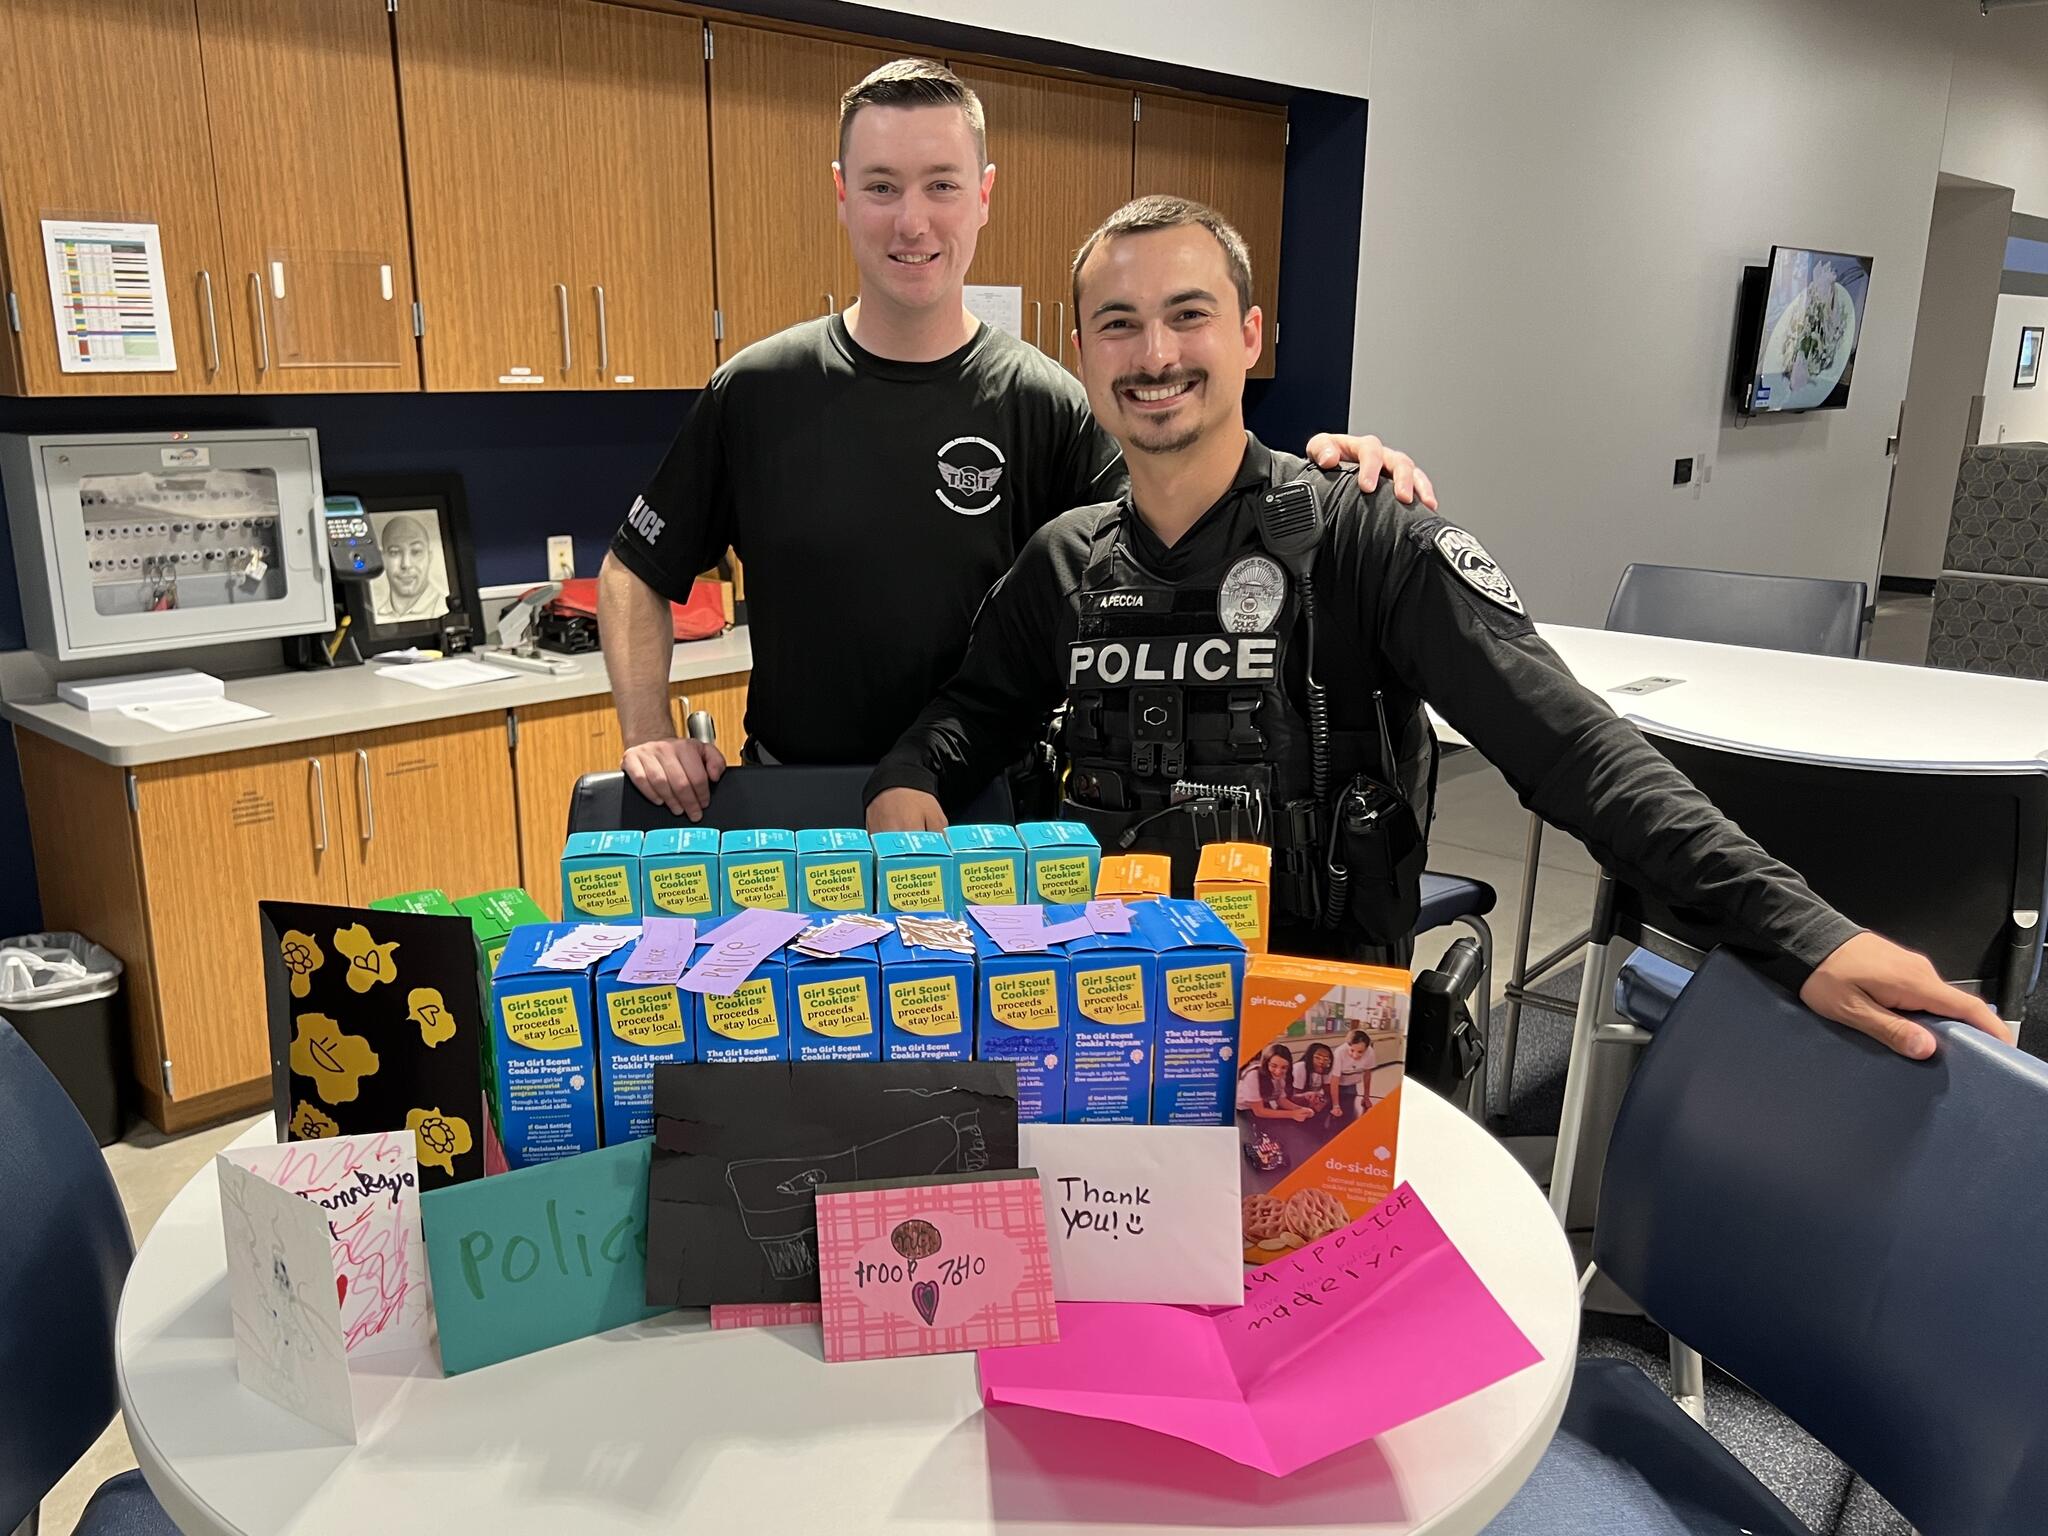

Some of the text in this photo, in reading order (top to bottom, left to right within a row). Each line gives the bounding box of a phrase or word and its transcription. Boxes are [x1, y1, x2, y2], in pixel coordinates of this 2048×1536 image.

[1232, 619, 1260, 629] POLICE
[1069, 638, 1277, 685] POLICE
[732, 866, 780, 879] Girl Scout
[810, 867, 856, 879] Girl Scout
[964, 864, 1010, 875] Girl Scout
[1040, 862, 1085, 873] Girl Scout
[573, 871, 622, 884] Girl Scout
[654, 870, 702, 882] Girl Scout
[738, 875, 776, 886] Cookies
[815, 875, 852, 886] Cookies
[890, 871, 937, 883] Girl Scout
[969, 872, 1006, 883] Cookies
[1045, 870, 1081, 880] Cookies
[580, 881, 618, 891] Cookies
[660, 879, 699, 889] Cookies
[736, 884, 774, 896] proceeds
[813, 884, 850, 896] proceeds
[896, 880, 933, 890] Cookies
[966, 880, 1003, 893] proceeds
[1042, 878, 1078, 890] proceeds
[1068, 885, 1090, 894] local.
[578, 889, 616, 901] proceeds
[657, 887, 696, 899] proceeds
[744, 891, 787, 902] stay local.
[821, 891, 862, 902] stay local.
[893, 889, 930, 900] proceeds
[974, 887, 1015, 899] stay local.
[1204, 894, 1253, 904] Girl Scout
[586, 896, 629, 908] stay local.
[666, 894, 709, 906] stay local.
[901, 896, 943, 907] stay local.
[1234, 920, 1258, 928] local.
[1082, 972, 1137, 988] Girl Scout
[1171, 970, 1227, 985] Girl Scout
[895, 983, 951, 998] Girl Scout
[994, 977, 1050, 992] Girl Scout
[1088, 983, 1132, 995] Cookies
[1177, 981, 1222, 993] Cookies
[734, 985, 767, 998] Scout
[804, 984, 861, 1000] Girl Scout
[1001, 988, 1046, 1000] Cookies
[1173, 991, 1218, 1005] proceeds
[508, 994, 568, 1012] Girl Scout
[613, 991, 673, 1008] Girl Scout
[715, 996, 762, 1010] Cookies
[810, 995, 856, 1008] Cookies
[901, 994, 946, 1007] Cookies
[997, 998, 1042, 1012] proceeds
[1084, 993, 1128, 1007] proceeds
[1183, 998, 1232, 1012] stay local.
[515, 1006, 564, 1021] Cookies
[620, 1003, 668, 1017] Cookies
[808, 1005, 853, 1020] proceeds
[898, 1004, 943, 1019] proceeds
[1007, 1005, 1056, 1020] stay local.
[1094, 1000, 1143, 1015] stay local.
[617, 1013, 665, 1029] proceeds
[712, 1007, 759, 1023] proceeds
[818, 1012, 869, 1028] stay local.
[908, 1011, 958, 1027] stay local.
[512, 1017, 561, 1033] proceeds
[628, 1020, 681, 1037] stay local.
[723, 1014, 775, 1031] stay local.
[524, 1024, 578, 1041] stay local.
[1325, 1158, 1389, 1177] do-si-dos
[1057, 1177, 1151, 1205] Thank
